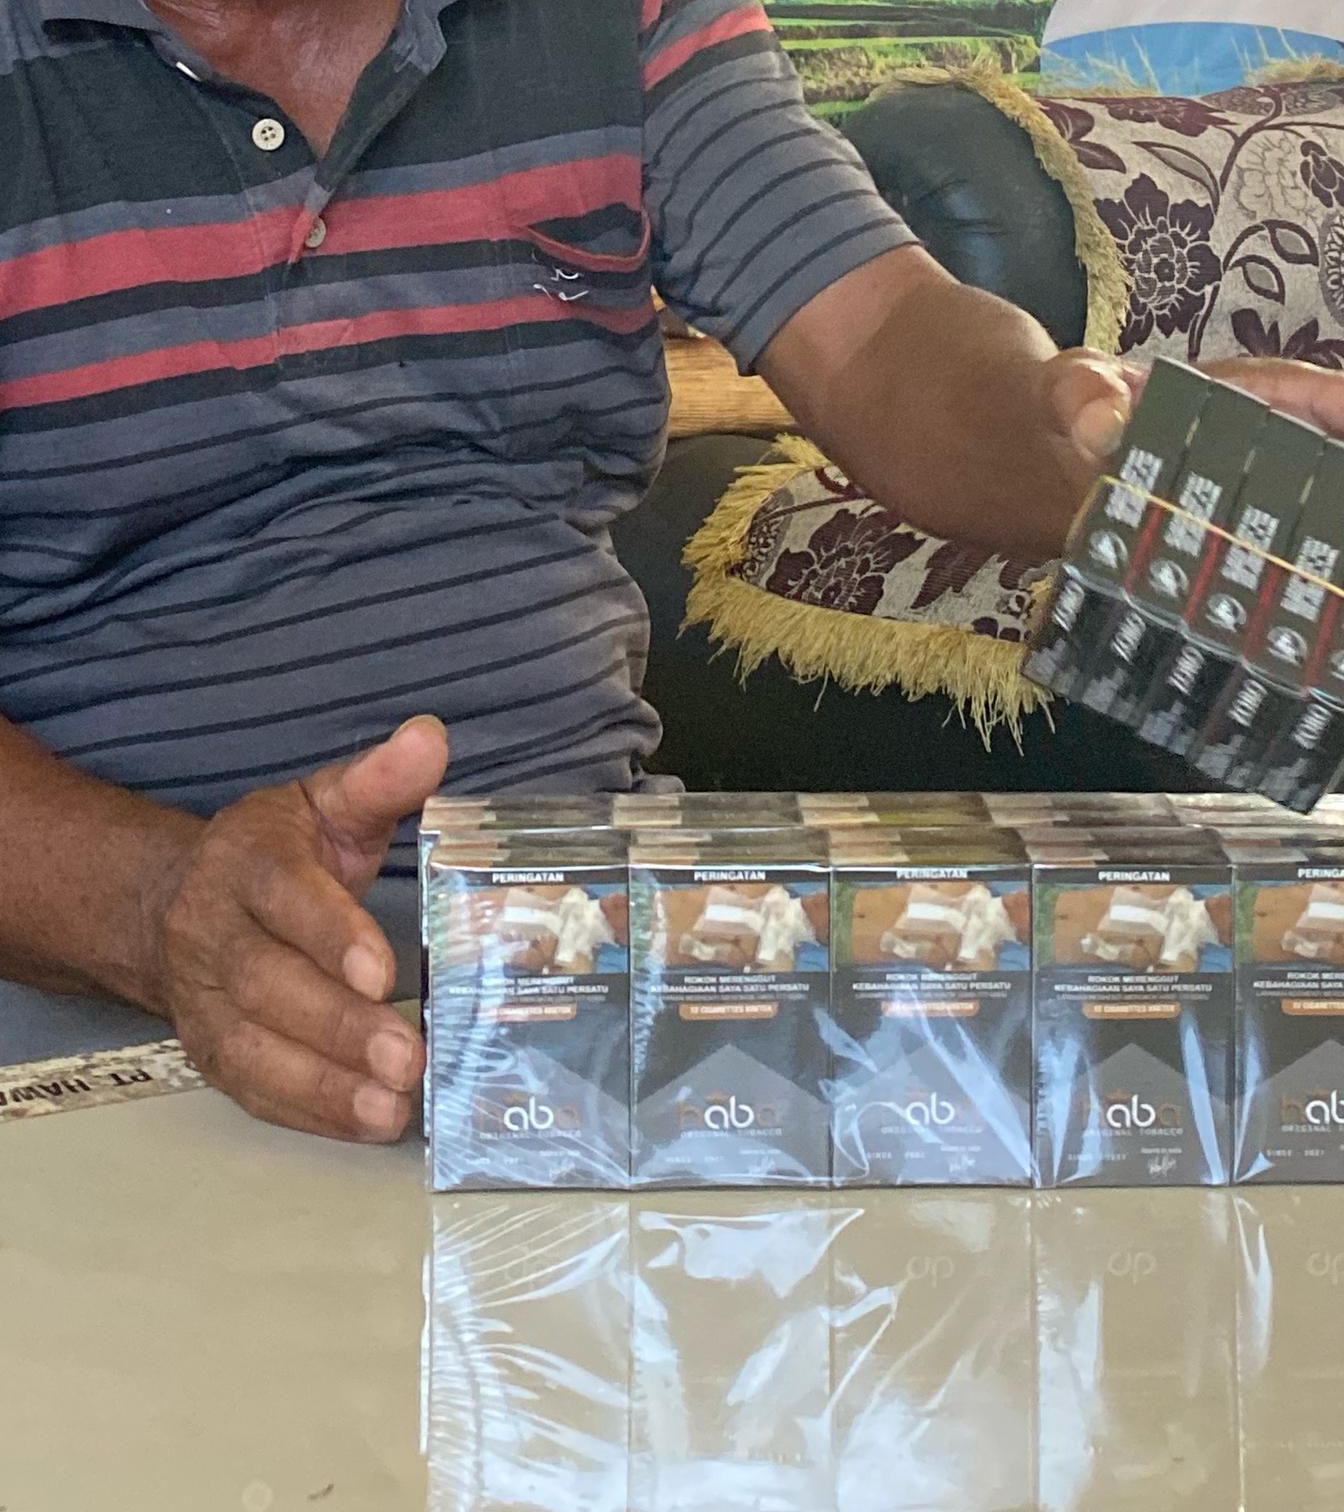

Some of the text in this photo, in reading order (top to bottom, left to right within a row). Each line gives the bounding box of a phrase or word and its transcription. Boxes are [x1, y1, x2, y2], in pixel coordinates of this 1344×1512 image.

[492, 872, 565, 883] PERINGATAN
[694, 871, 766, 881] PERINGATAN
[1098, 871, 1170, 882] PERINGATAN
[744, 984, 765, 992] SATU
[768, 983, 810, 991] PERSATU
[1147, 984, 1169, 992] SATU
[1171, 984, 1213, 992] PERSATU
